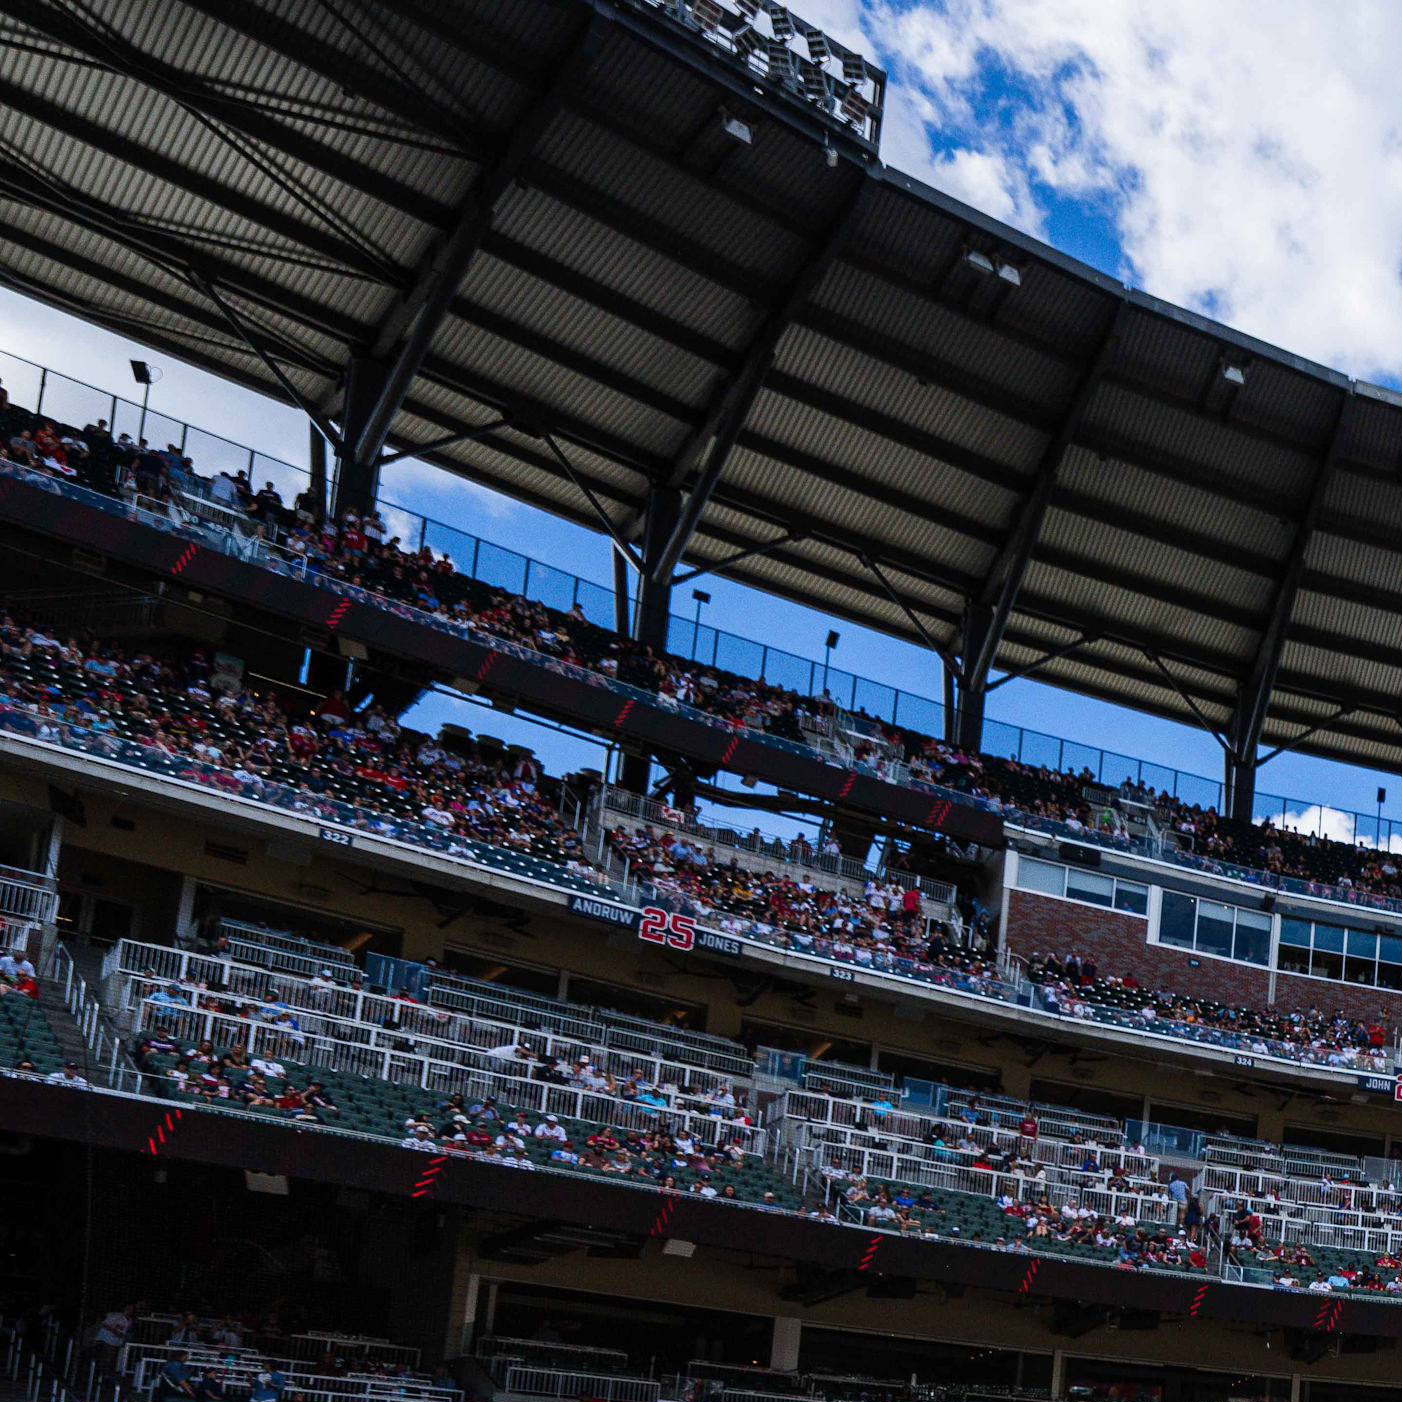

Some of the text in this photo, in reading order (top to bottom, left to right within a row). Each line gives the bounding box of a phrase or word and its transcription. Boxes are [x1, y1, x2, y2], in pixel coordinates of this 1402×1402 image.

[322, 830, 349, 845] 322
[573, 898, 740, 954] ANDRUW 25 JONES
[832, 969, 852, 980] 323
[1366, 1078, 1391, 1091] JOHN
